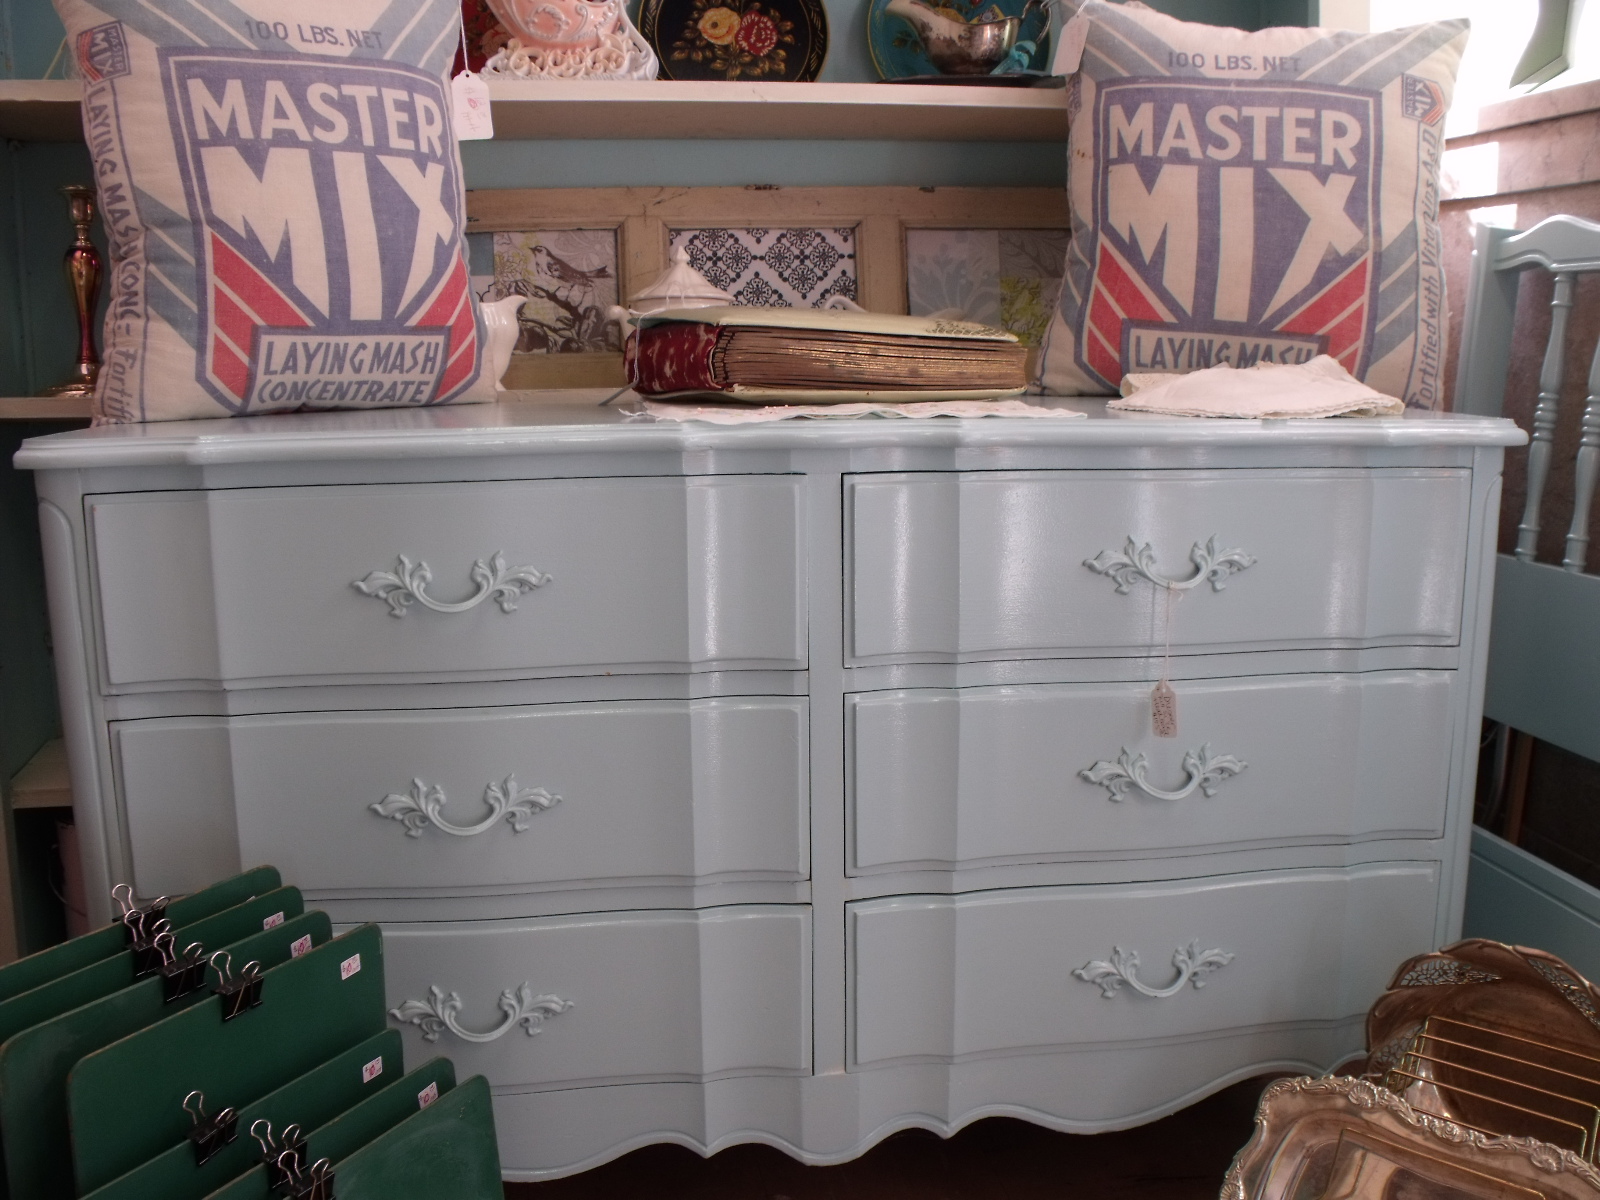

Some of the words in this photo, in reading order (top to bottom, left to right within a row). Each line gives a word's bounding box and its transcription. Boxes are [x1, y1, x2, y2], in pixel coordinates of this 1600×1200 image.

[91, 32, 114, 75] MIX
[107, 29, 124, 70] MASTER
[245, 20, 289, 40] 100
[297, 24, 344, 46] LBS.
[346, 29, 383, 49] NET
[1168, 52, 1205, 68] 100
[1214, 54, 1258, 71] LBS.
[1263, 56, 1301, 72] NET
[187, 77, 442, 158] MASTER
[1405, 77, 1415, 115] MASTER
[1414, 81, 1432, 117] MIX
[87, 86, 116, 176] LAYING
[1109, 102, 1362, 170] MASTER
[1421, 128, 1438, 177] A&D
[201, 146, 455, 321] MIX
[1108, 163, 1365, 325] MIX
[1423, 275, 1439, 319] with
[263, 340, 368, 376] LAYING
[368, 340, 440, 375] MASH
[1135, 335, 1231, 369] LAYING
[1405, 317, 1438, 410] Fortified
[257, 378, 431, 404] CONCENTRATE
